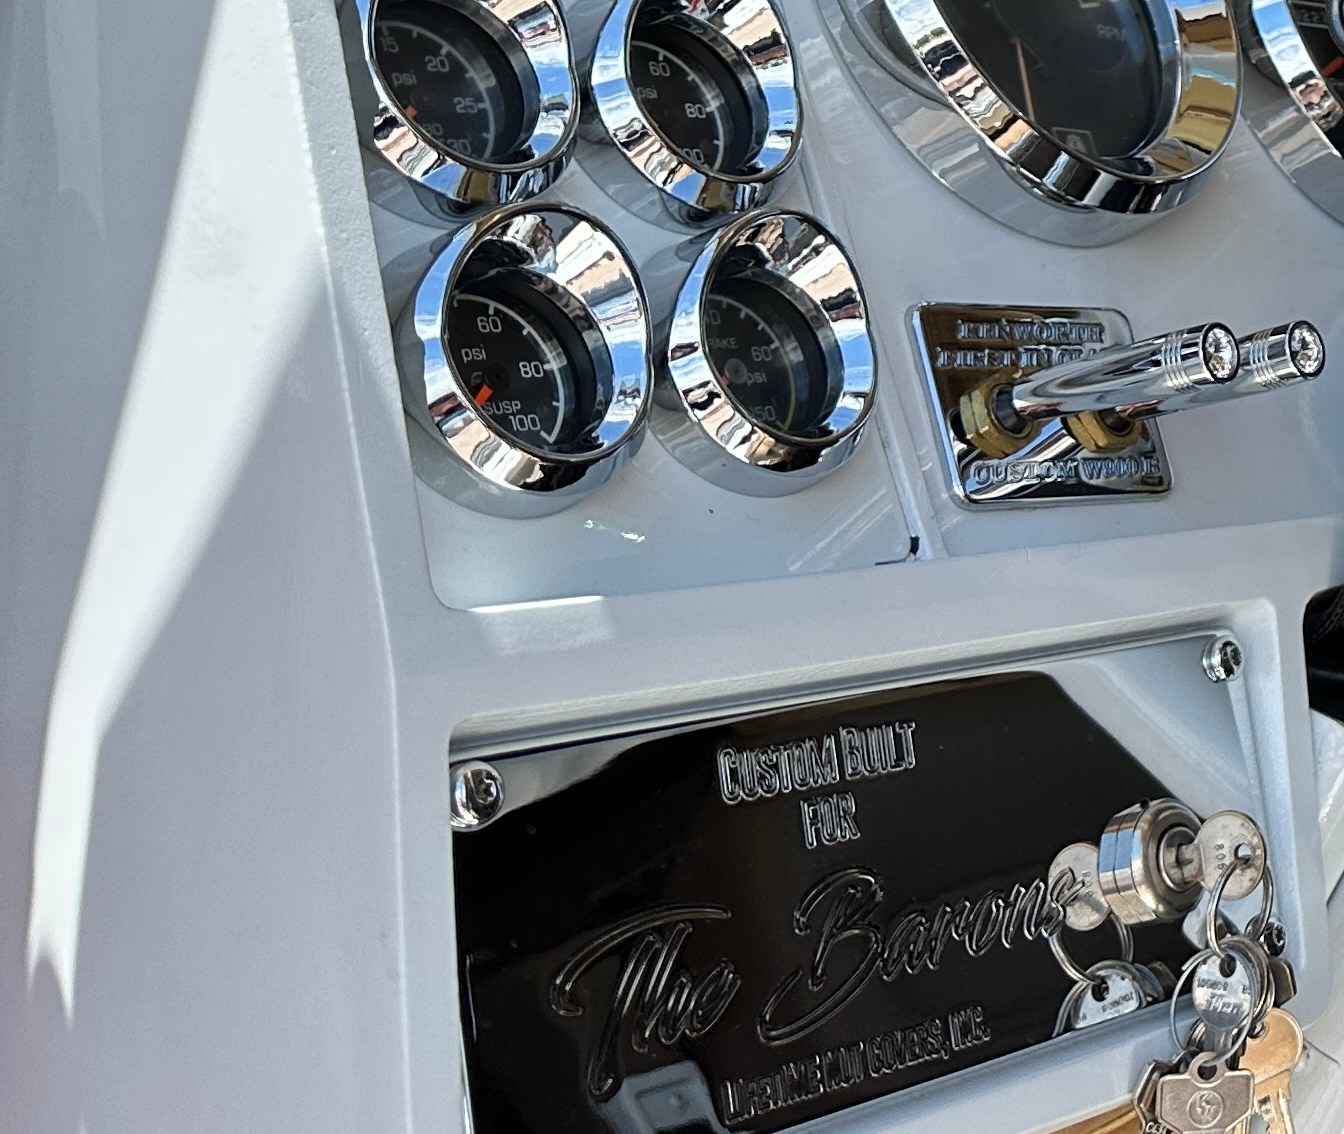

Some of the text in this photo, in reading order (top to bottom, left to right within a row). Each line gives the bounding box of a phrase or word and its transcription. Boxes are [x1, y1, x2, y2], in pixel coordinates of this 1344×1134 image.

[379, 36, 400, 54] 15
[424, 55, 450, 72] 20
[648, 61, 671, 77] 60
[391, 69, 418, 87] psi
[453, 97, 479, 114] 25
[684, 102, 707, 119] 80
[477, 315, 503, 334] 60
[461, 343, 487, 364] psi
[751, 345, 773, 363] 60
[519, 360, 544, 379] 80
[484, 399, 522, 416] SUSP
[509, 413, 541, 432] 100
[971, 457, 1079, 486] CUSTOM
[549, 864, 1090, 1103] The Barons
